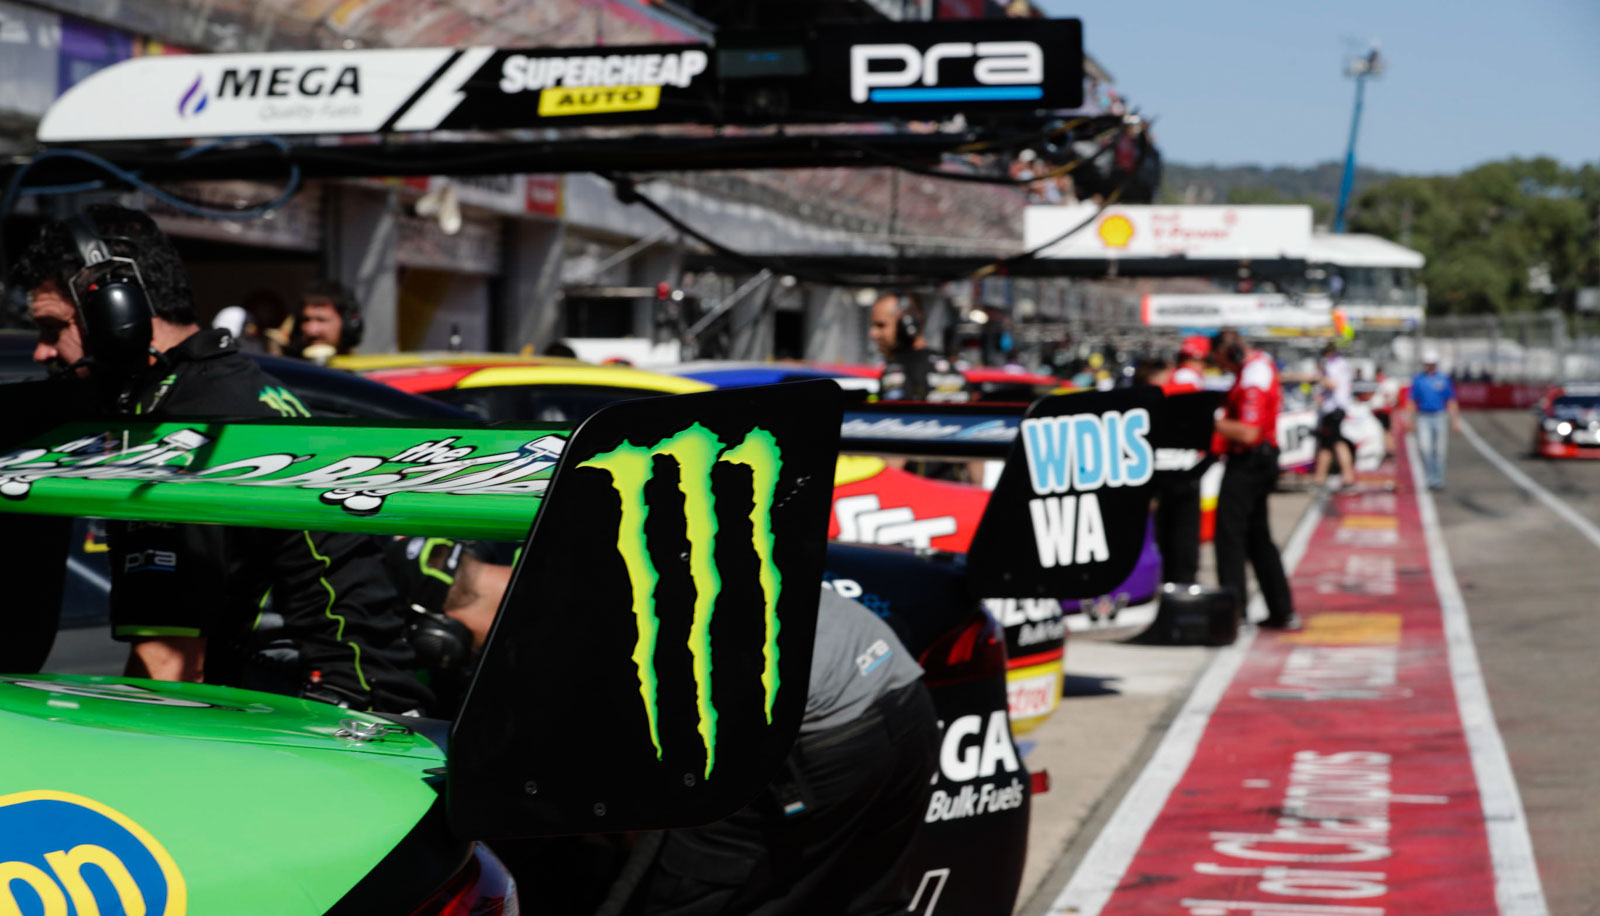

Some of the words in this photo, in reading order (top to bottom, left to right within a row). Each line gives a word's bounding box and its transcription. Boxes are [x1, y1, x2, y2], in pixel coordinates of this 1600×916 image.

[216, 66, 361, 98] MEGA
[500, 50, 708, 93] SUPERCHEAP
[556, 89, 643, 107] AUTO
[850, 41, 1044, 103] pra
[1021, 408, 1156, 495] WDIS
[1029, 492, 1110, 569] WA
[931, 710, 1020, 783] GA
[925, 784, 979, 823] Bulk
[976, 777, 1024, 815] Fuels
